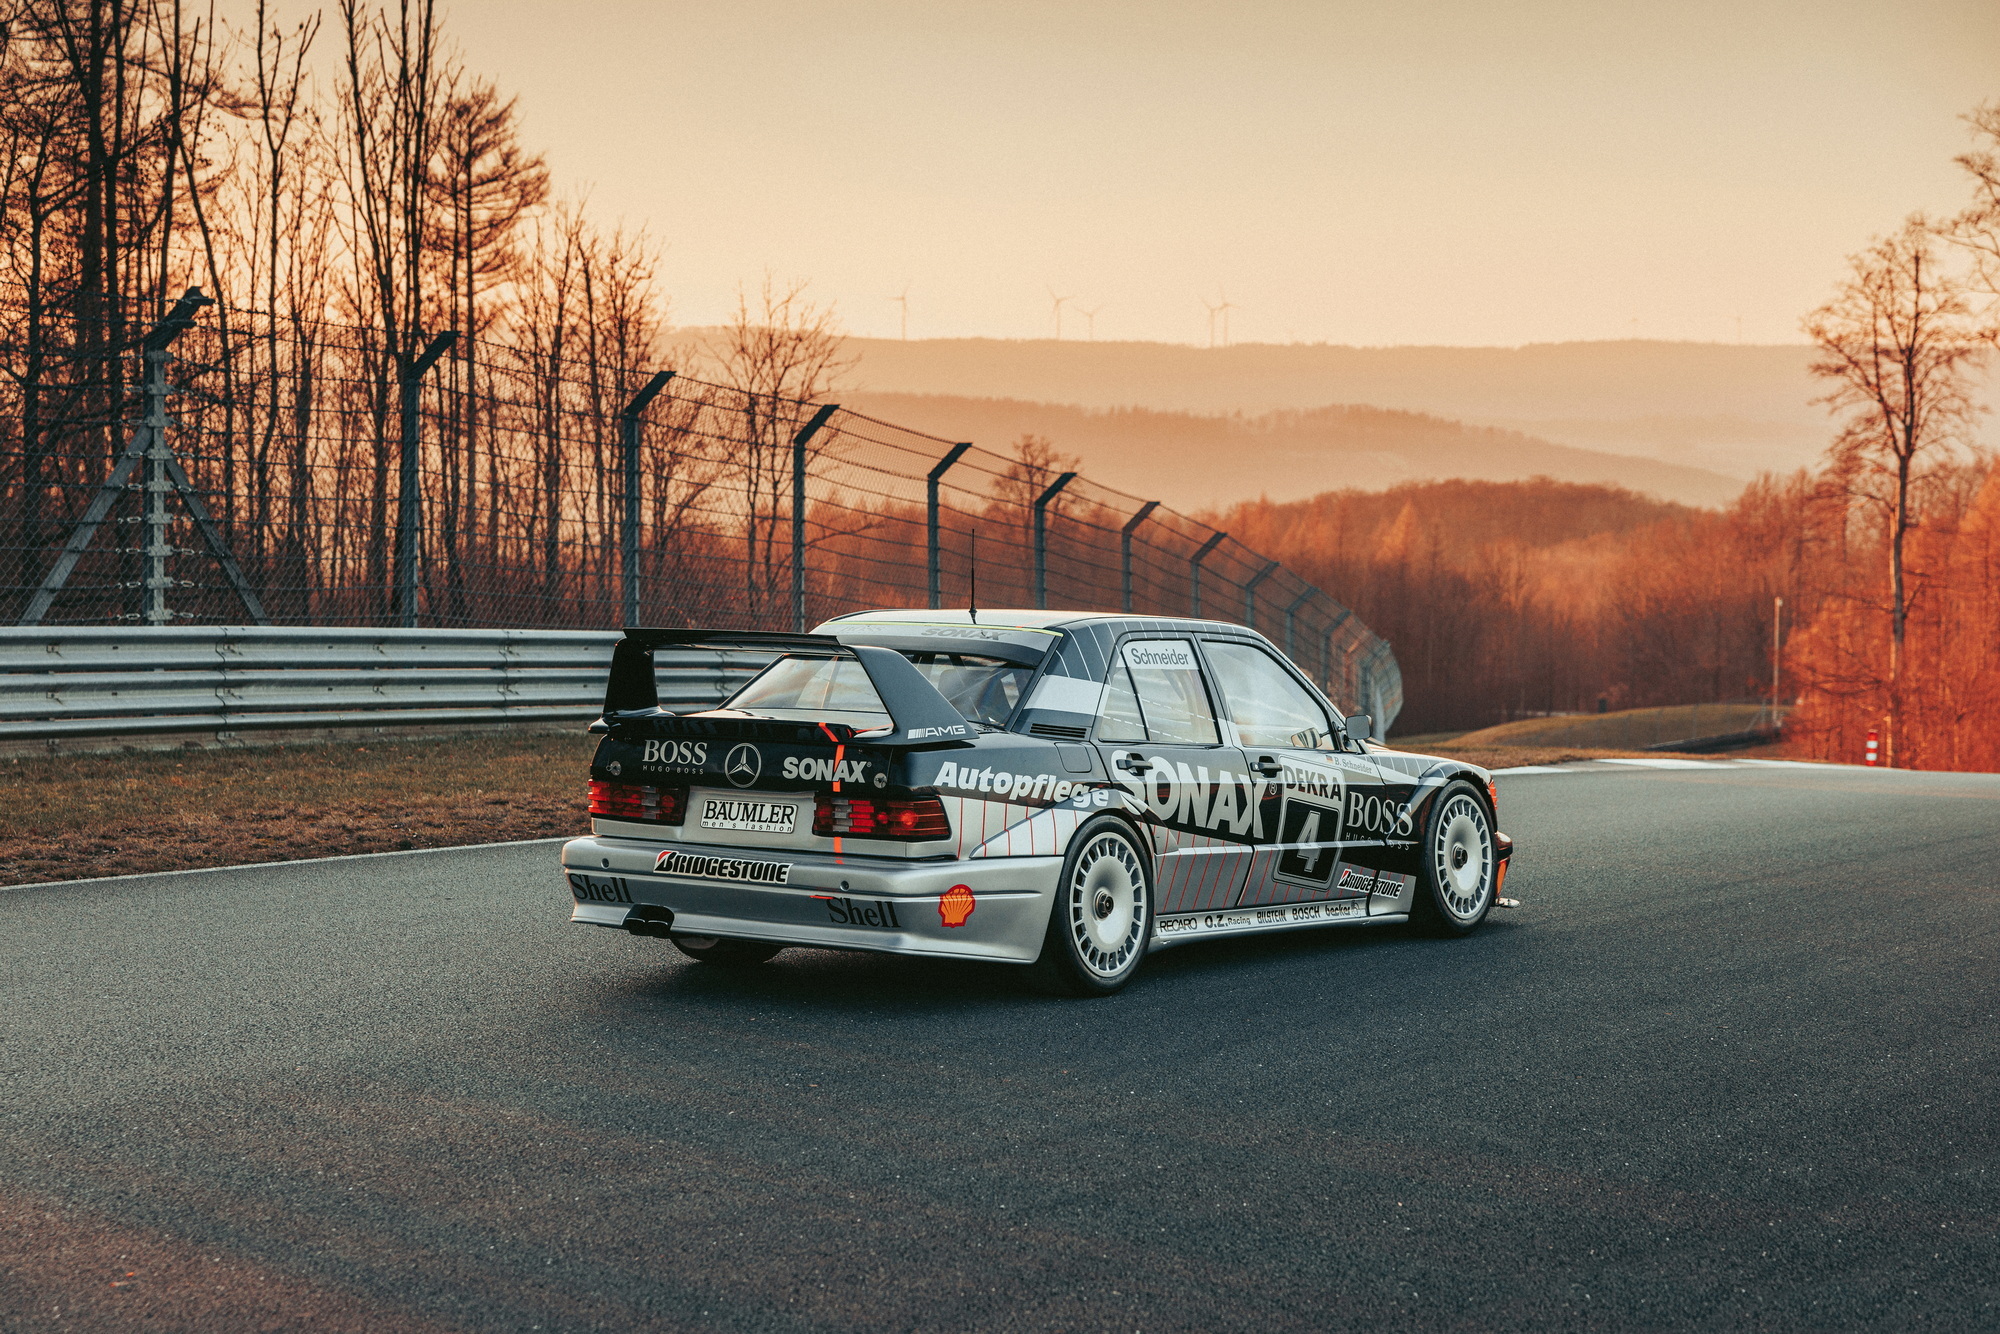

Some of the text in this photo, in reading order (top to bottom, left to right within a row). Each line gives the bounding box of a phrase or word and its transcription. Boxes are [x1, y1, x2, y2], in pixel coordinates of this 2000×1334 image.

[1130, 647, 1189, 667] Schneider
[924, 725, 966, 738] AMG
[642, 739, 708, 766] BOSS
[642, 765, 704, 775] HUGO BOSS
[933, 761, 1109, 809] Autopflege
[1283, 764, 1342, 802] DEKRA
[703, 800, 795, 825] BÄUMLER
[1346, 791, 1413, 836] BOSS
[702, 820, 793, 832] men's fashion
[1296, 809, 1322, 873] 4
[654, 850, 792, 884] BRIDGESTONE
[569, 873, 634, 904] Shell
[825, 897, 901, 928] Shell
[1159, 917, 1198, 933] RECARO
[1227, 916, 1251, 926] Racing
[1256, 908, 1287, 924] BILSTEIN
[1292, 906, 1320, 920] BOSCH
